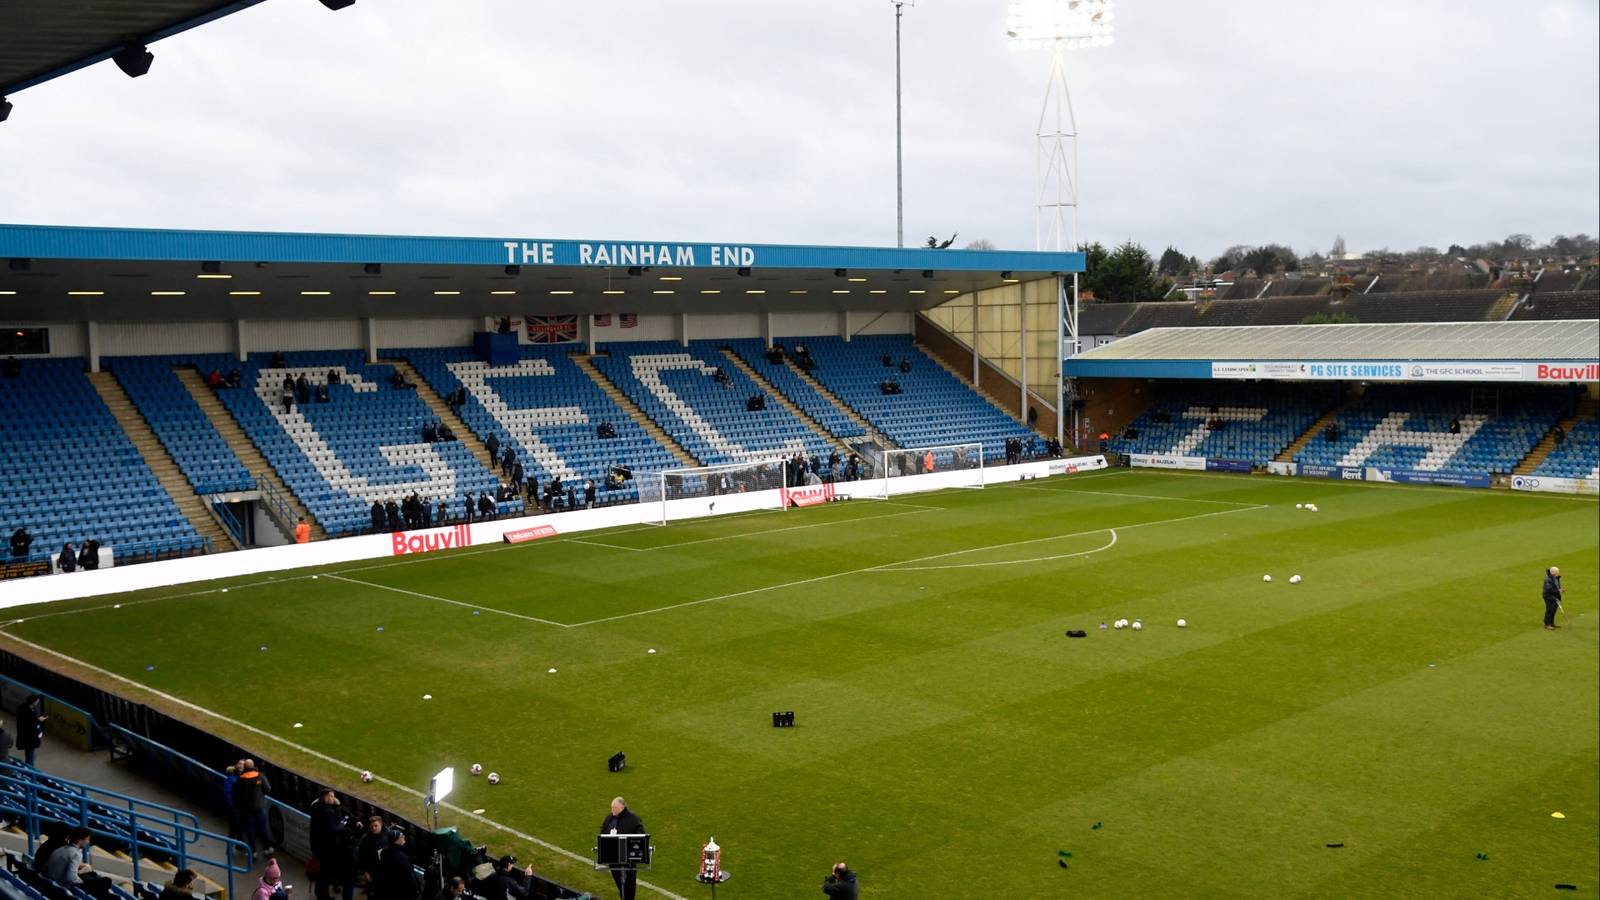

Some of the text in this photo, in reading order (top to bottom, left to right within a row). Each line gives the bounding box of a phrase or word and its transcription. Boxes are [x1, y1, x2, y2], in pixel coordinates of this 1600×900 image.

[503, 242, 755, 266] THE RAINHAM END
[1310, 365, 1324, 377] PG
[1327, 365, 1348, 377] SITE
[1351, 365, 1402, 377] SERVICES
[1537, 365, 1600, 380] Bauvill
[1342, 472, 1362, 481] Kent
[392, 523, 471, 556] Bauvill
